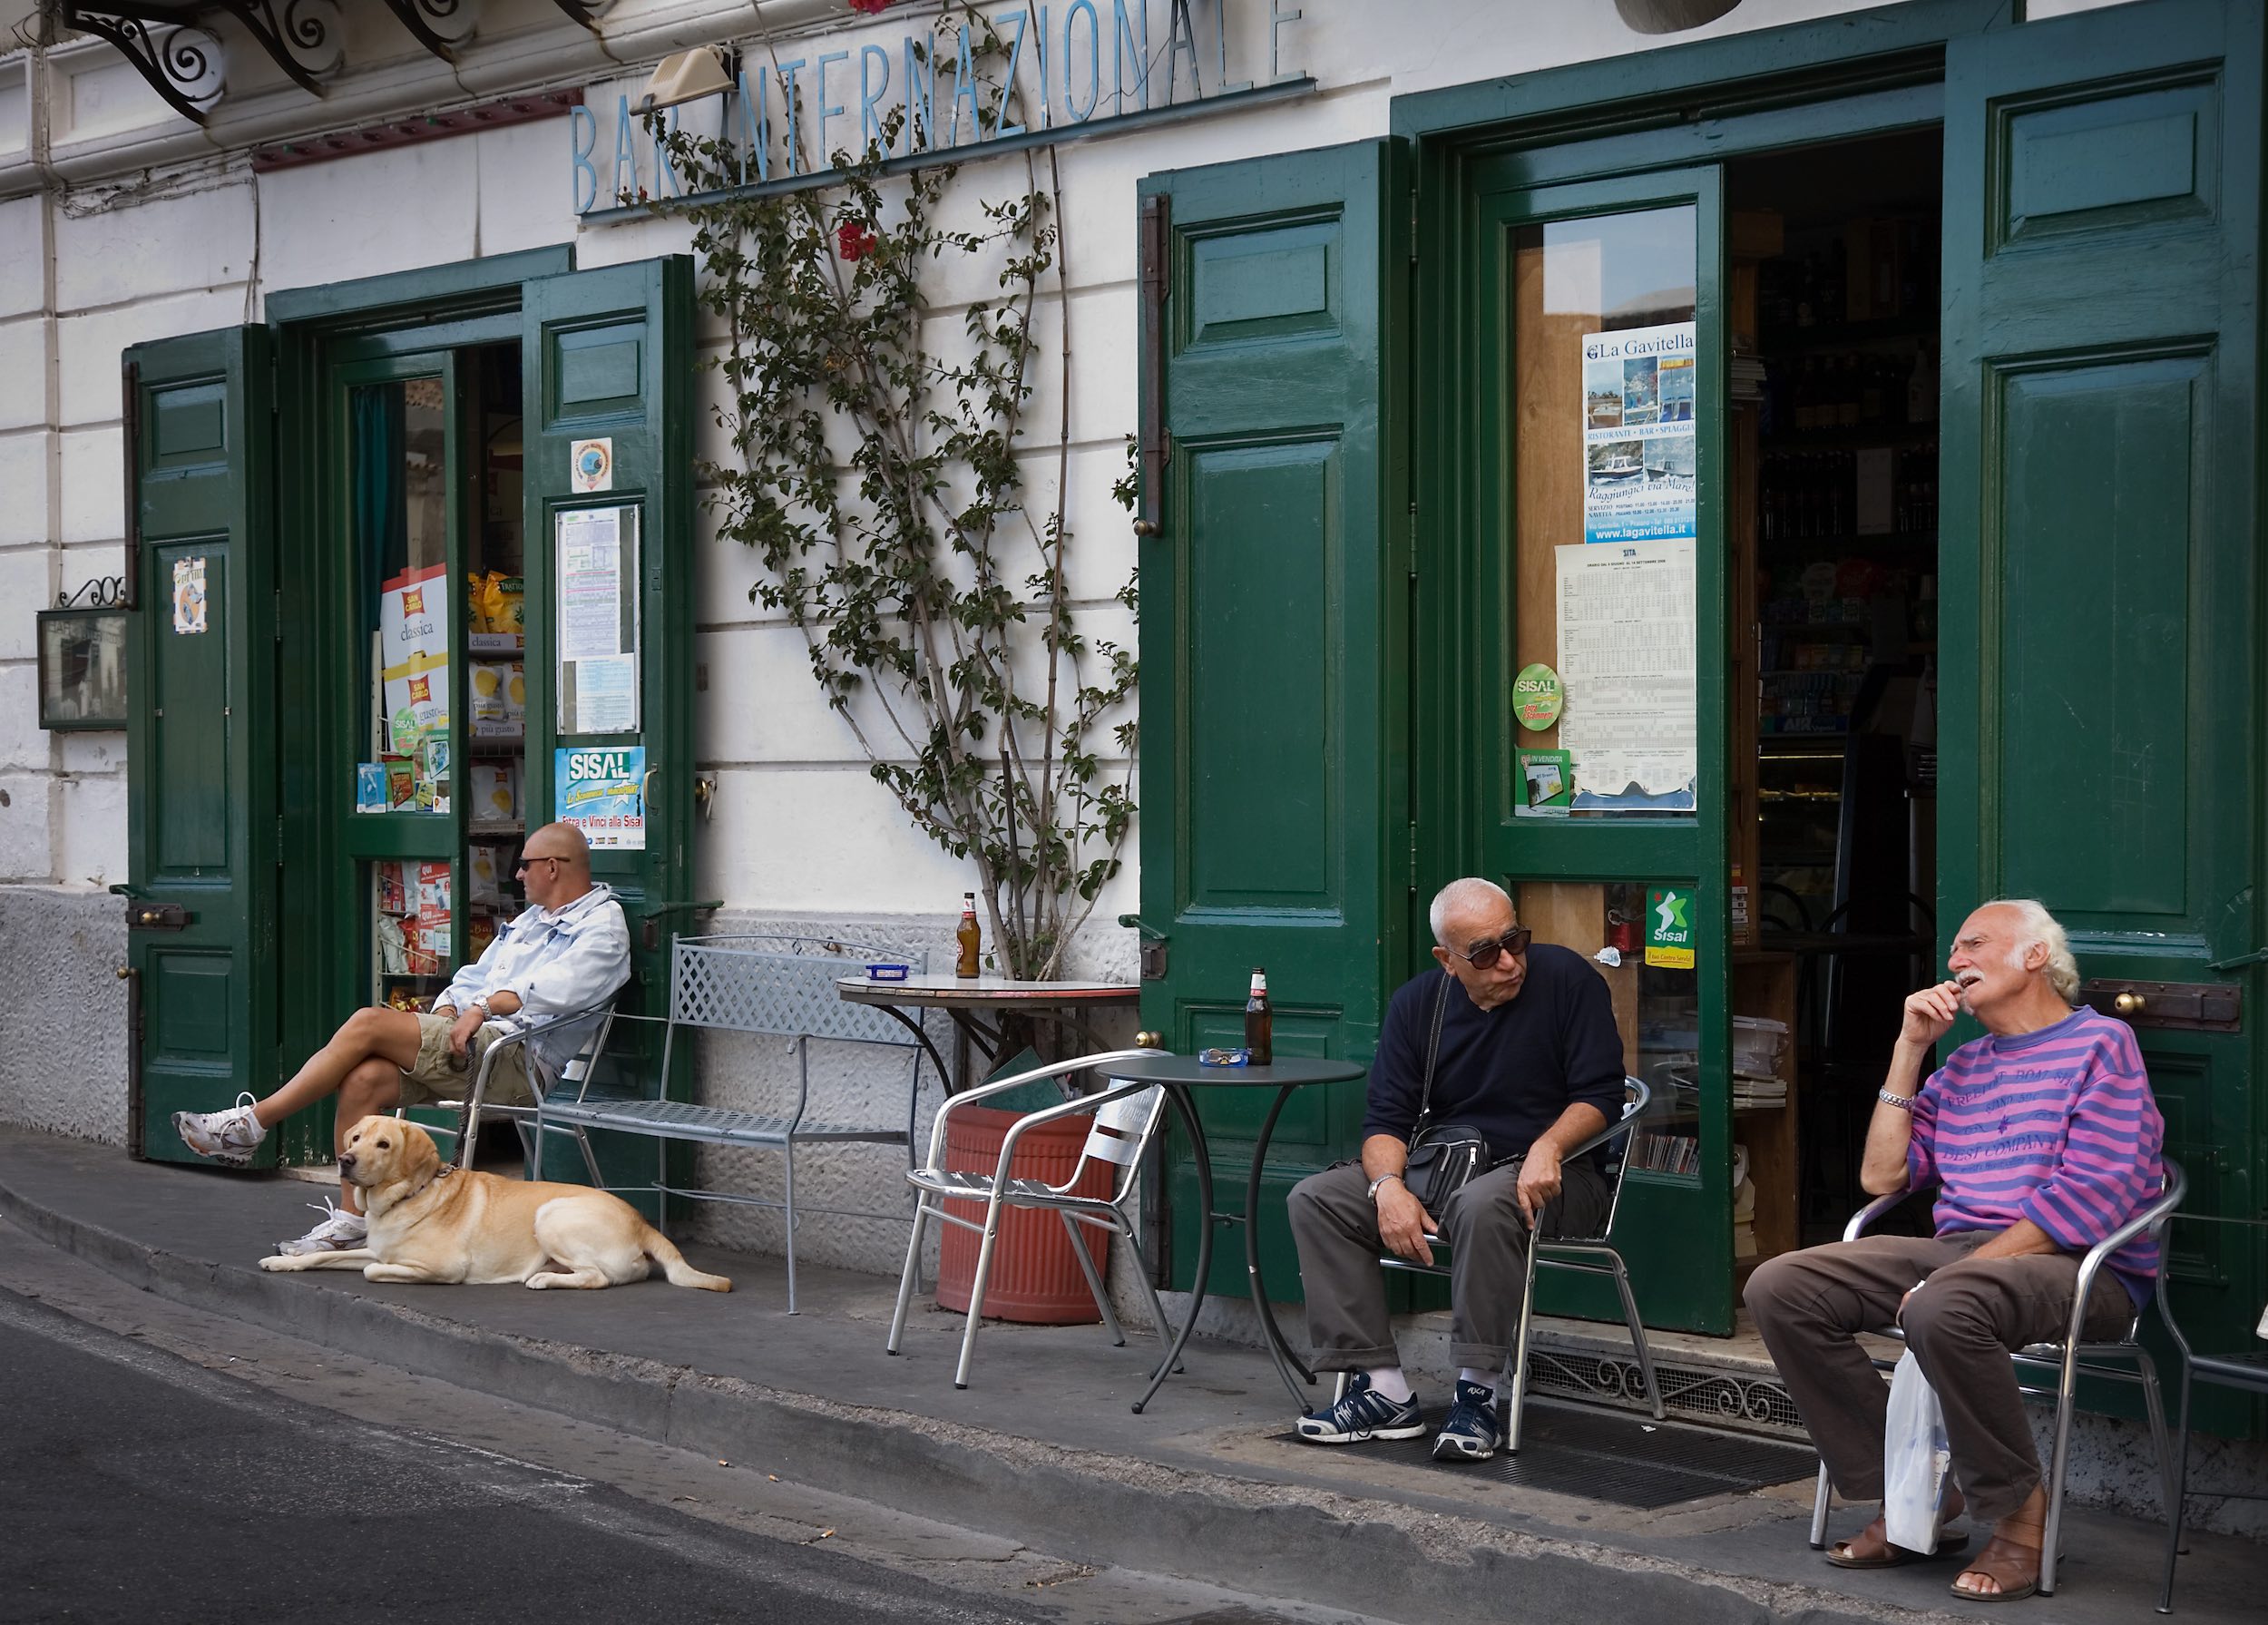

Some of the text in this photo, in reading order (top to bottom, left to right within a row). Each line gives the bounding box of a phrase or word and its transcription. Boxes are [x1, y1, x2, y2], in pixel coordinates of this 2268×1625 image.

[571, 94, 680, 216] BAR
[1600, 344, 1618, 357] La
[1625, 334, 1694, 355] Gavitella
[1639, 426, 1654, 436] BAR
[1660, 424, 1695, 434] SPIAGGIA
[1589, 477, 1696, 504] Raggiungici via Mare!
[1596, 524, 1686, 540] www.lagavitella.it
[1623, 549, 1637, 557] SITA
[407, 595, 418, 603] SAN
[406, 601, 423, 612] CARLO
[400, 620, 434, 641] classica
[472, 636, 501, 647] classica
[413, 681, 425, 691] SAN
[1518, 680, 1554, 692] SISAL
[411, 690, 429, 700] CARLO
[481, 725, 515, 736] più gusto
[570, 753, 630, 779] SISAL
[582, 818, 587, 827] e
[589, 815, 607, 827] Vinci
[609, 815, 621, 827] alla
[623, 814, 643, 827] Sisal
[1653, 927, 1688, 943] Sisal
[1941, 1133, 2058, 1161] BEST COMPANY
[1467, 1386, 1485, 1396] AXA
